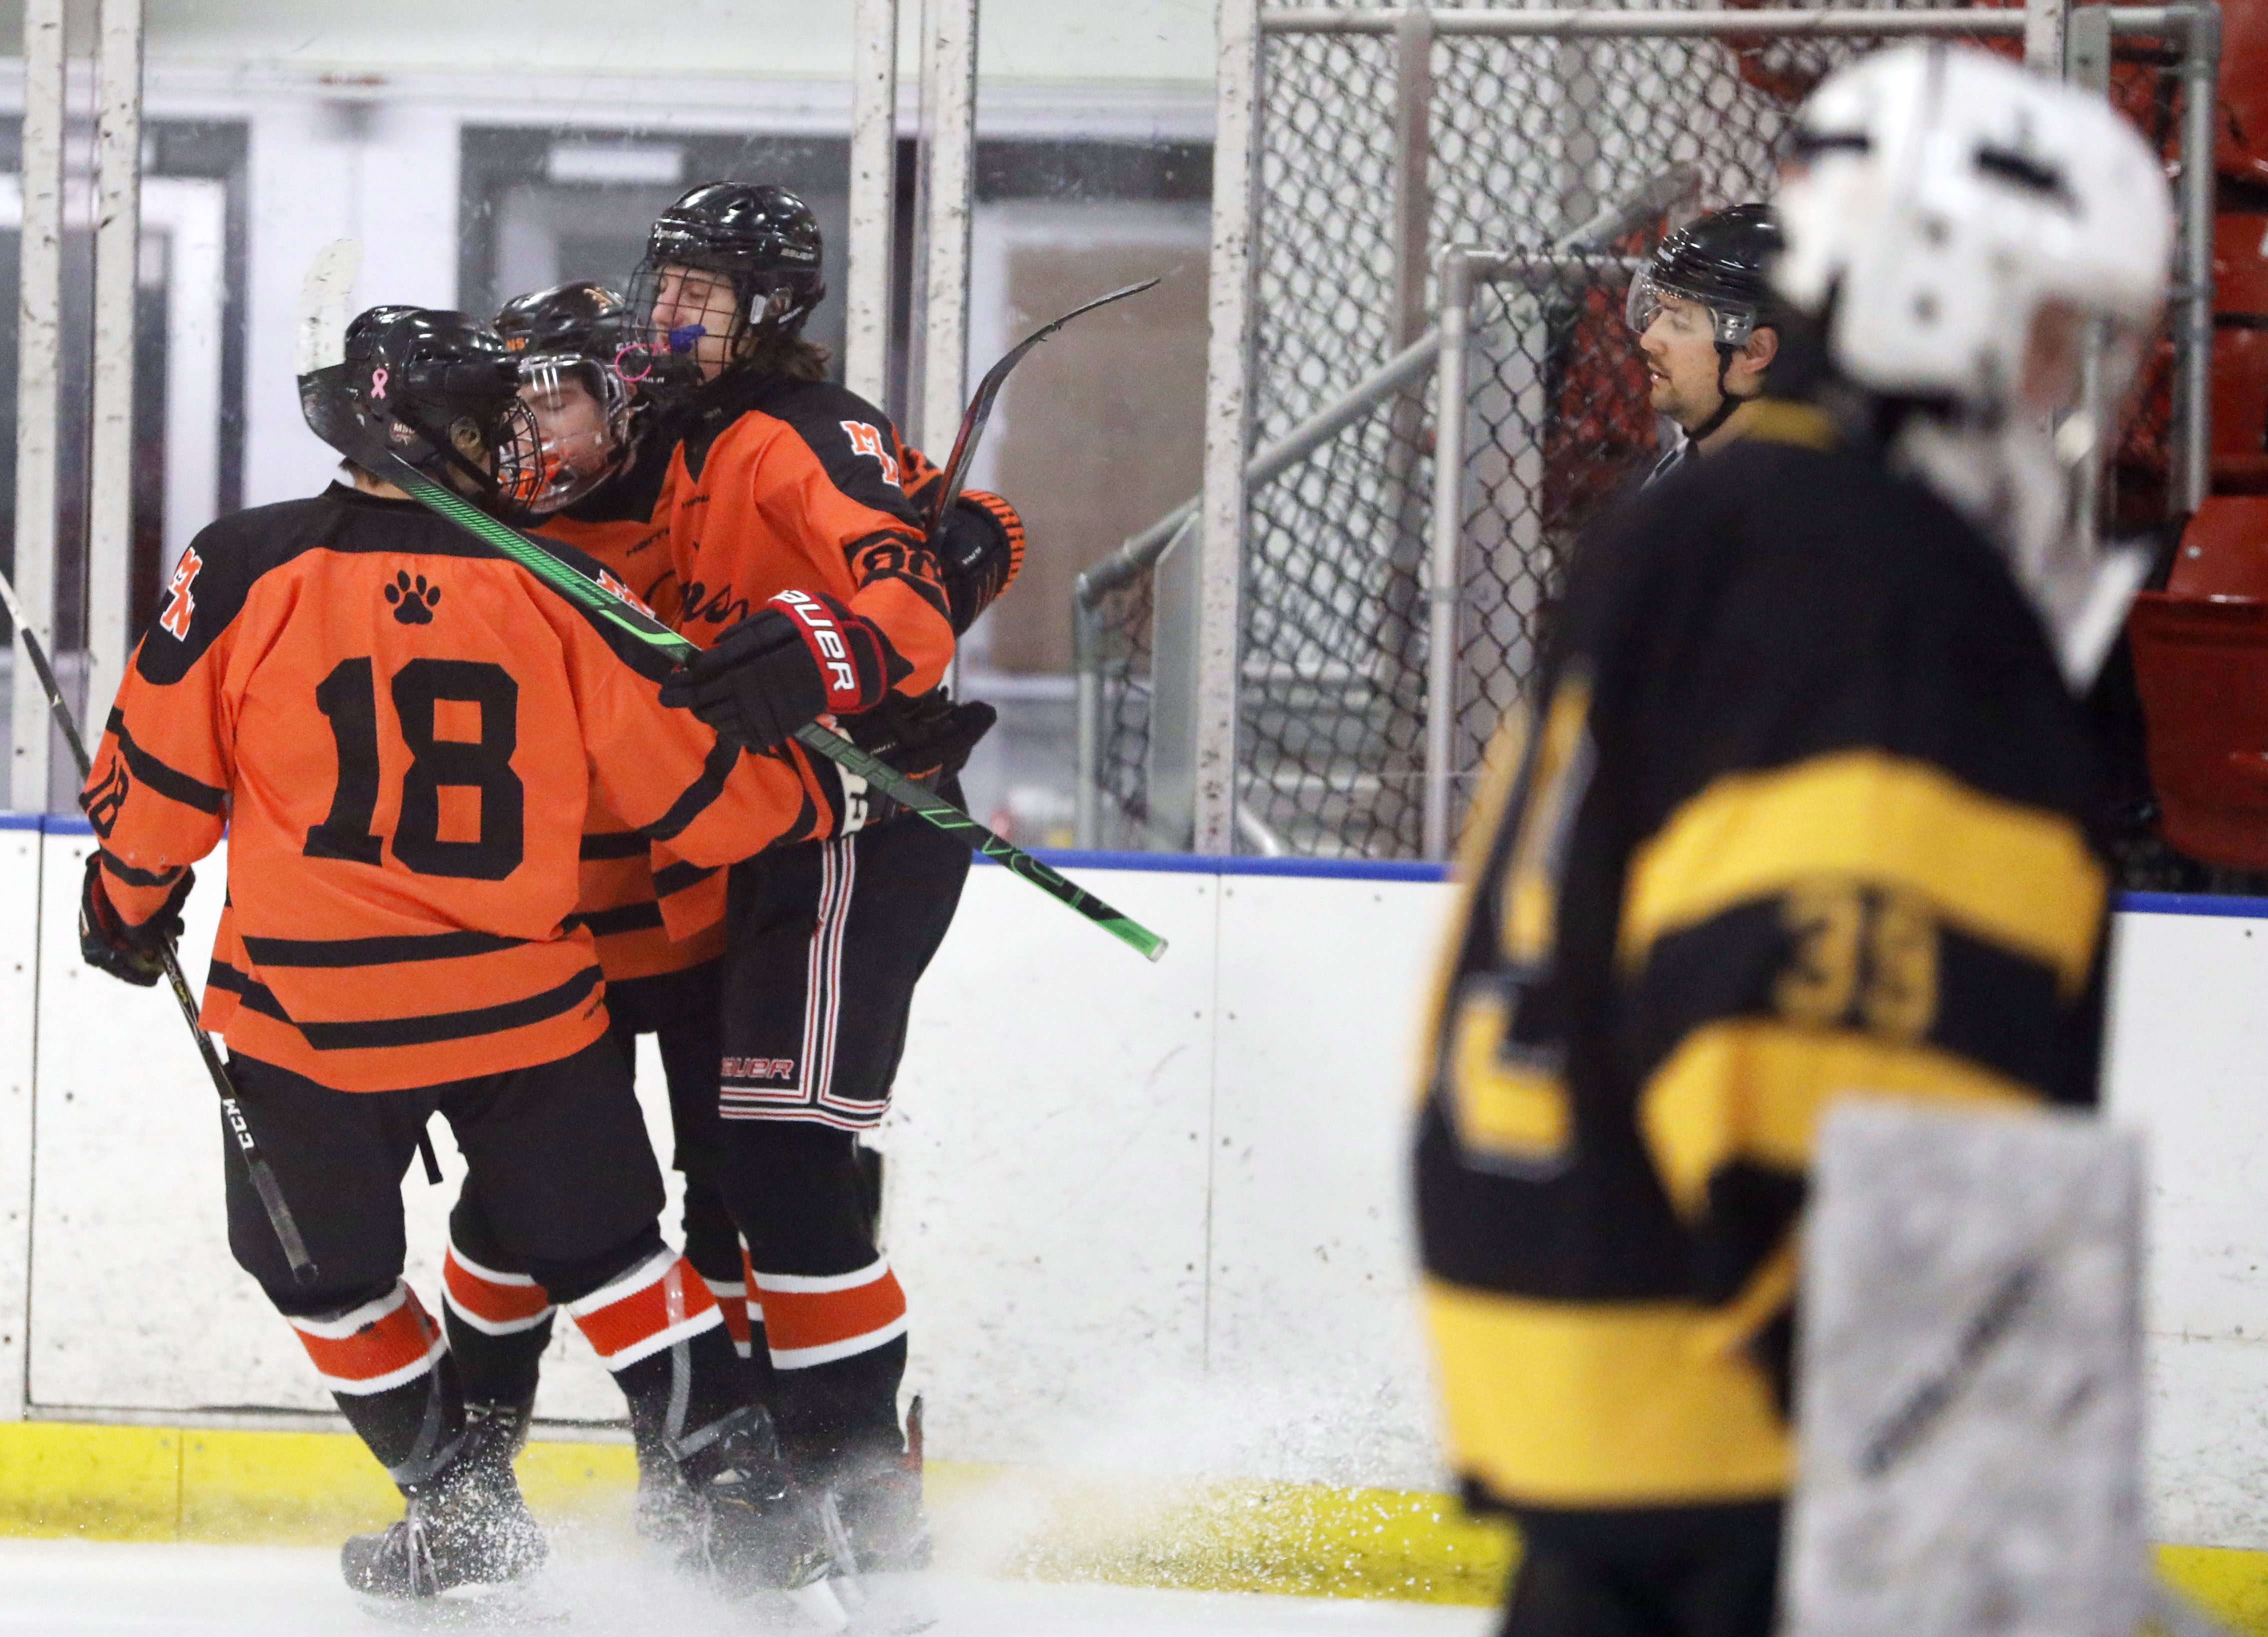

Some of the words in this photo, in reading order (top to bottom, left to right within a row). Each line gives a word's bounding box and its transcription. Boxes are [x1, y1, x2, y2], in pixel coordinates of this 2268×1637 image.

[78, 754, 129, 839] 18
[302, 656, 524, 882] 18
[720, 1056, 794, 1080] AUER
[222, 1098, 255, 1150] CCM
